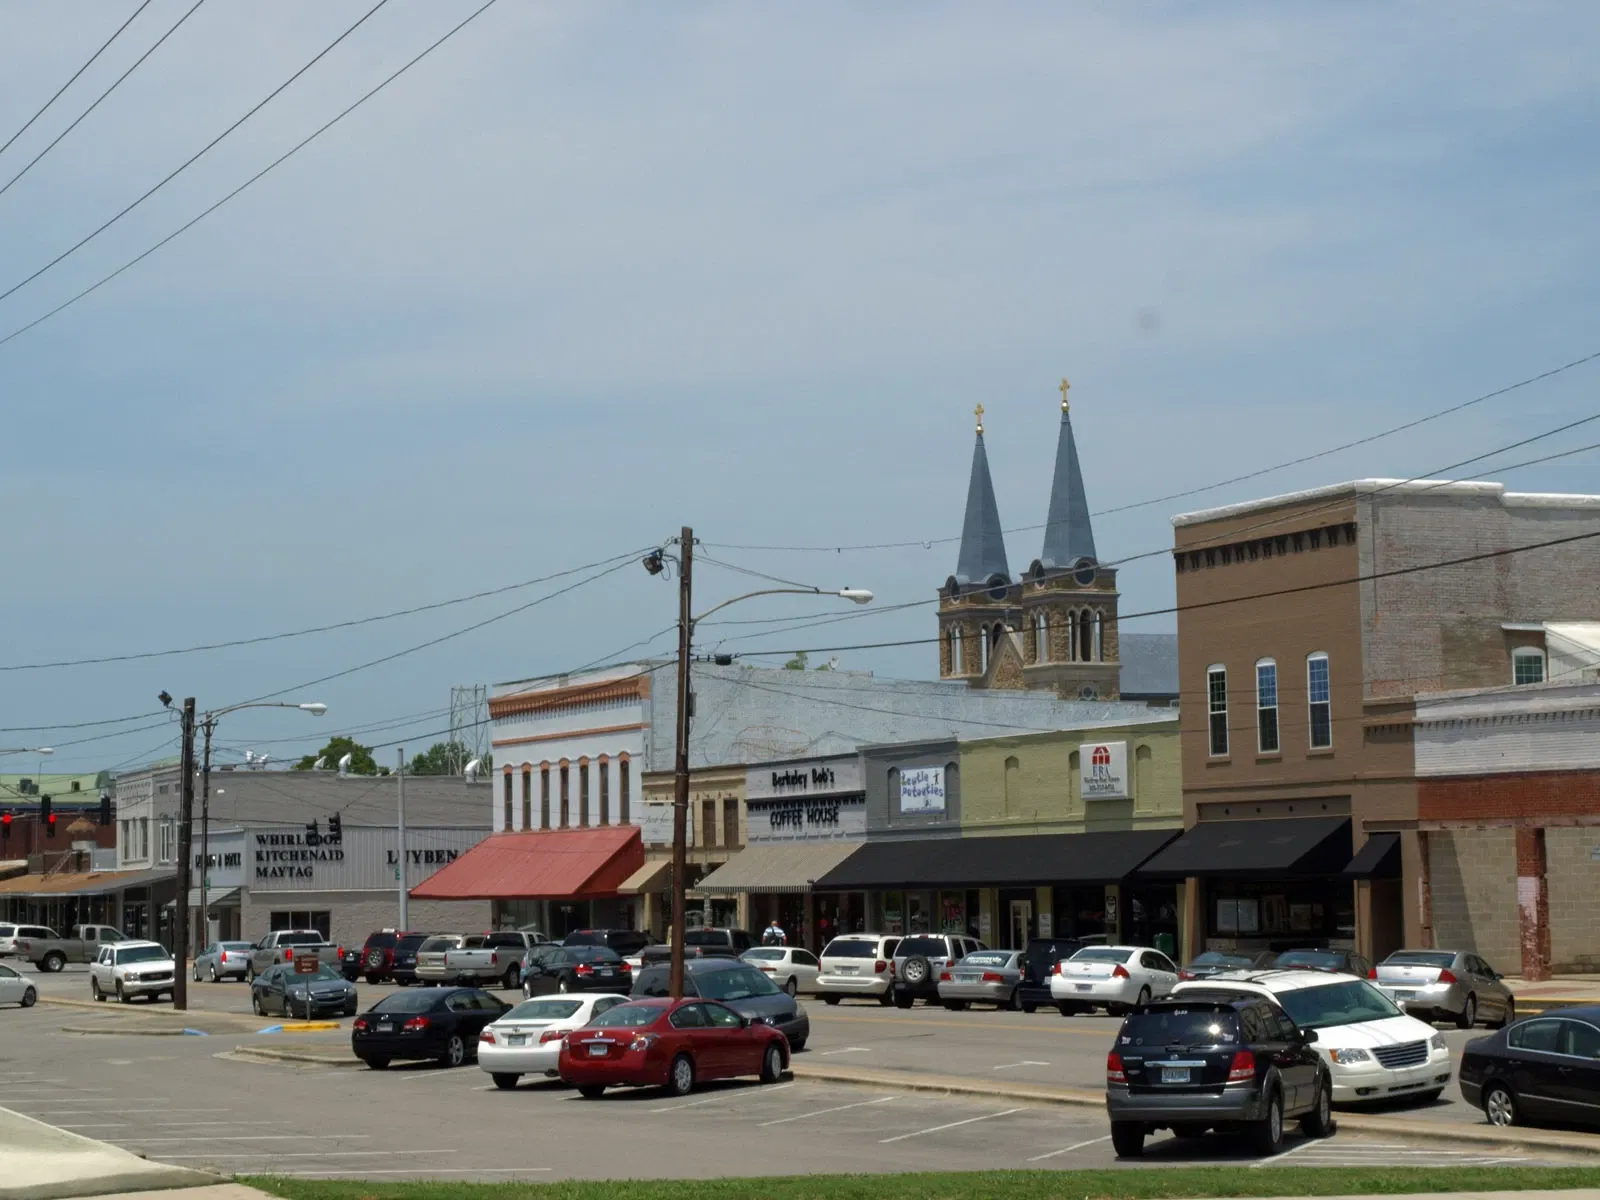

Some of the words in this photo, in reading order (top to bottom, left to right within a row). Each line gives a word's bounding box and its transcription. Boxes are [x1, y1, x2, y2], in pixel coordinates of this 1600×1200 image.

[772, 769, 807, 789] Berkeley
[812, 767, 835, 784] Bob's
[770, 809, 803, 826] COFFEE
[807, 806, 839, 823] HOUSE
[256, 834, 342, 846] WHIRLOL
[256, 850, 345, 862] KITCHENAID
[256, 866, 313, 878] MAYTAG
